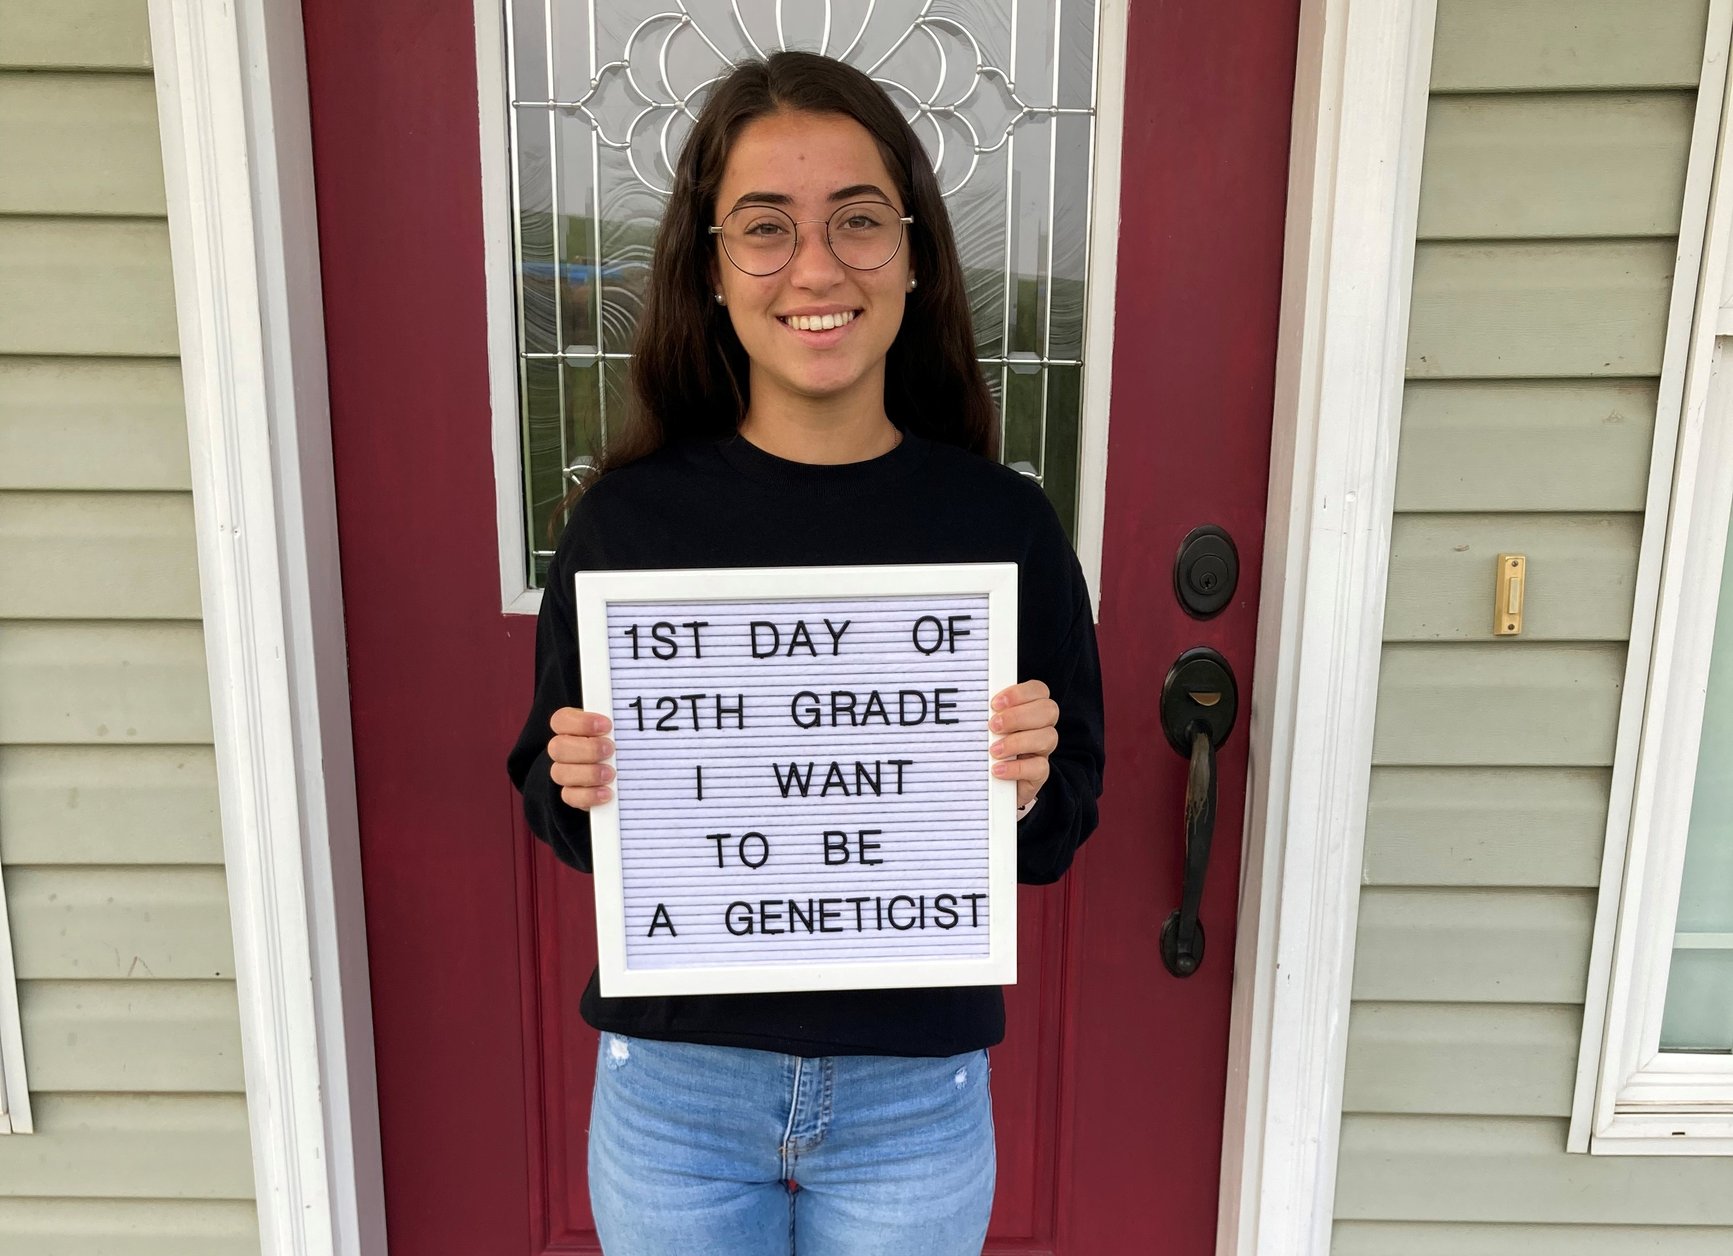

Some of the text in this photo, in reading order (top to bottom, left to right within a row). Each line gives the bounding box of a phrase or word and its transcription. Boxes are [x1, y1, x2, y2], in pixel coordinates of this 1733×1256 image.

[624, 615, 972, 660] 1ST DAY OF
[629, 688, 959, 732] 12TH GRADE
[695, 759, 913, 801] I WANT
[706, 829, 883, 870] TO BE
[647, 893, 987, 938] A GENETICIST
